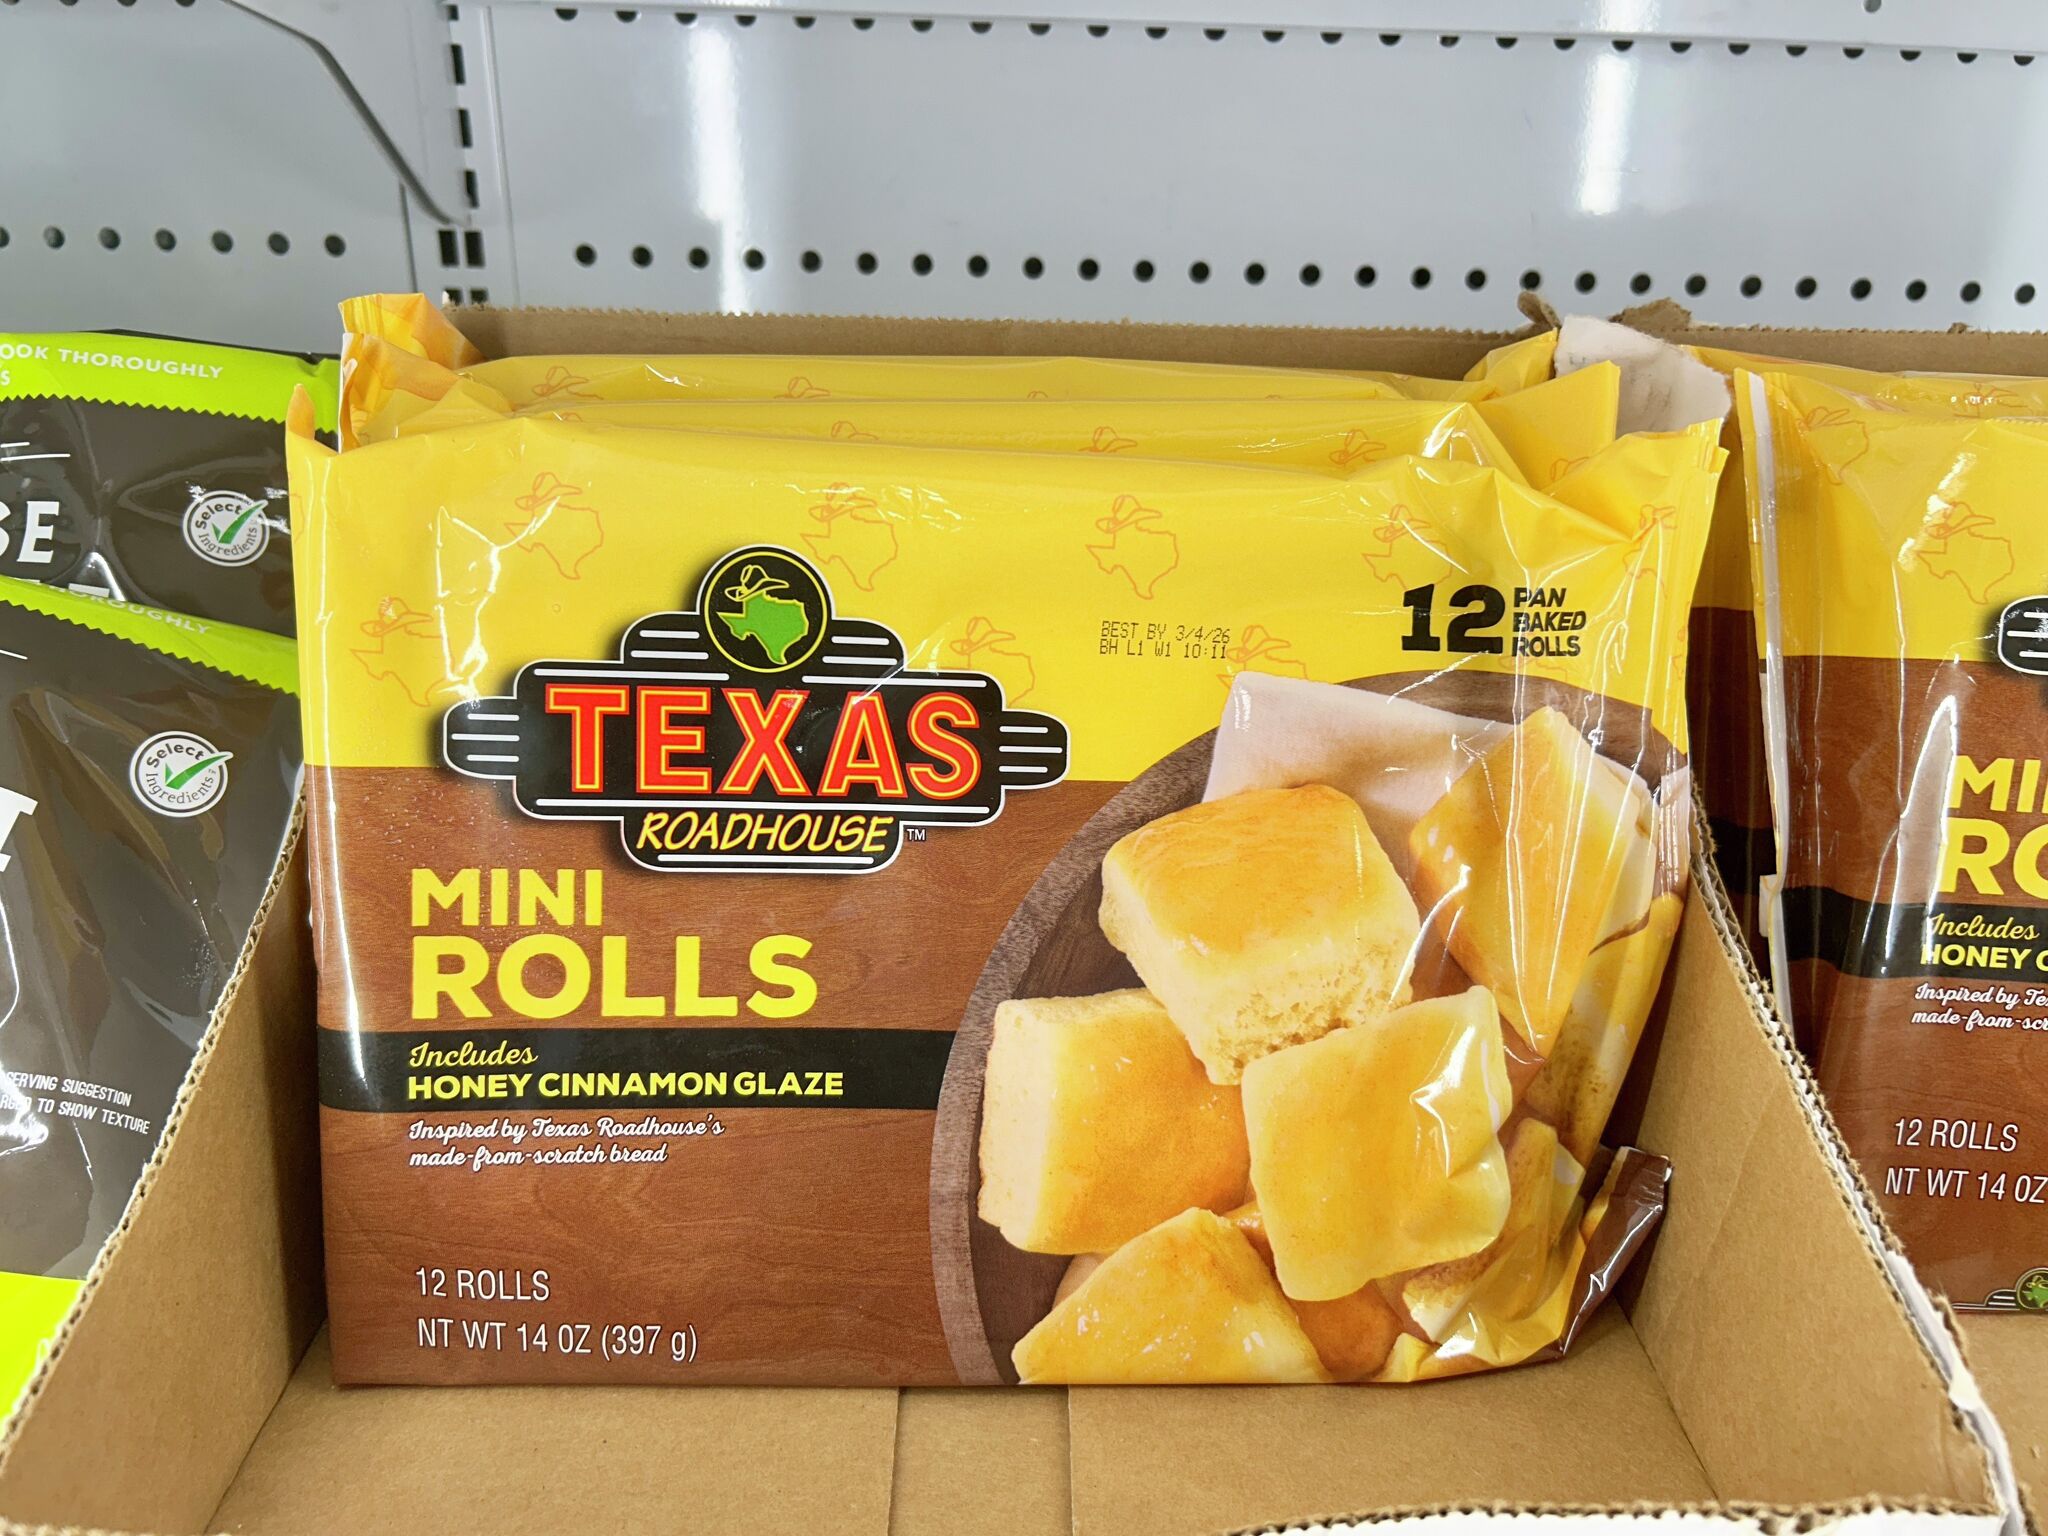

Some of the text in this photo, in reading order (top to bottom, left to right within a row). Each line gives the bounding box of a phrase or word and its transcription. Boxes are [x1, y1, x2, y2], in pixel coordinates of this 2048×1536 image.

[58, 347, 224, 379] THOROUGHLY
[195, 503, 243, 530] Select
[198, 527, 258, 556] Ingredients
[1513, 587, 1567, 608] PAN
[1101, 620, 1231, 644] BEST BY 3/4/26
[1401, 584, 1506, 654] 12
[1513, 610, 1587, 632] BAKED
[1100, 638, 1226, 659] BH L1 W1 10:11
[1511, 636, 1581, 657] ROLLS
[545, 682, 982, 799] TEXAS
[146, 743, 205, 768] Select
[145, 773, 214, 804] Ingredients
[635, 811, 895, 853] ROADHOUSE
[411, 868, 603, 927] MINI
[1927, 913, 2040, 940] Includes
[1920, 944, 2032, 970] HONEY
[411, 934, 818, 1019] ROLLS
[1915, 983, 1994, 1006] Inspired
[1995, 986, 2021, 1010] by
[408, 1040, 539, 1068] Includes
[61, 1078, 132, 1107] SUGGESTION
[408, 1071, 844, 1100] HONEY CINNAMON GLAZE
[37, 1097, 55, 1113] TO
[58, 1101, 98, 1120] SHOW
[101, 1109, 151, 1135] TEXTURE
[408, 1114, 725, 1147] Inspired by Texas Roadhouse's
[1894, 1118, 2020, 1152] 12 ROLLS
[408, 1142, 667, 1171] made-from-scratch bread
[1884, 1167, 2048, 1204] NT WT 14 OZ
[416, 1267, 550, 1301] 12 ROLLS
[417, 1318, 698, 1362] NT WT 14 OZ (397 g)
